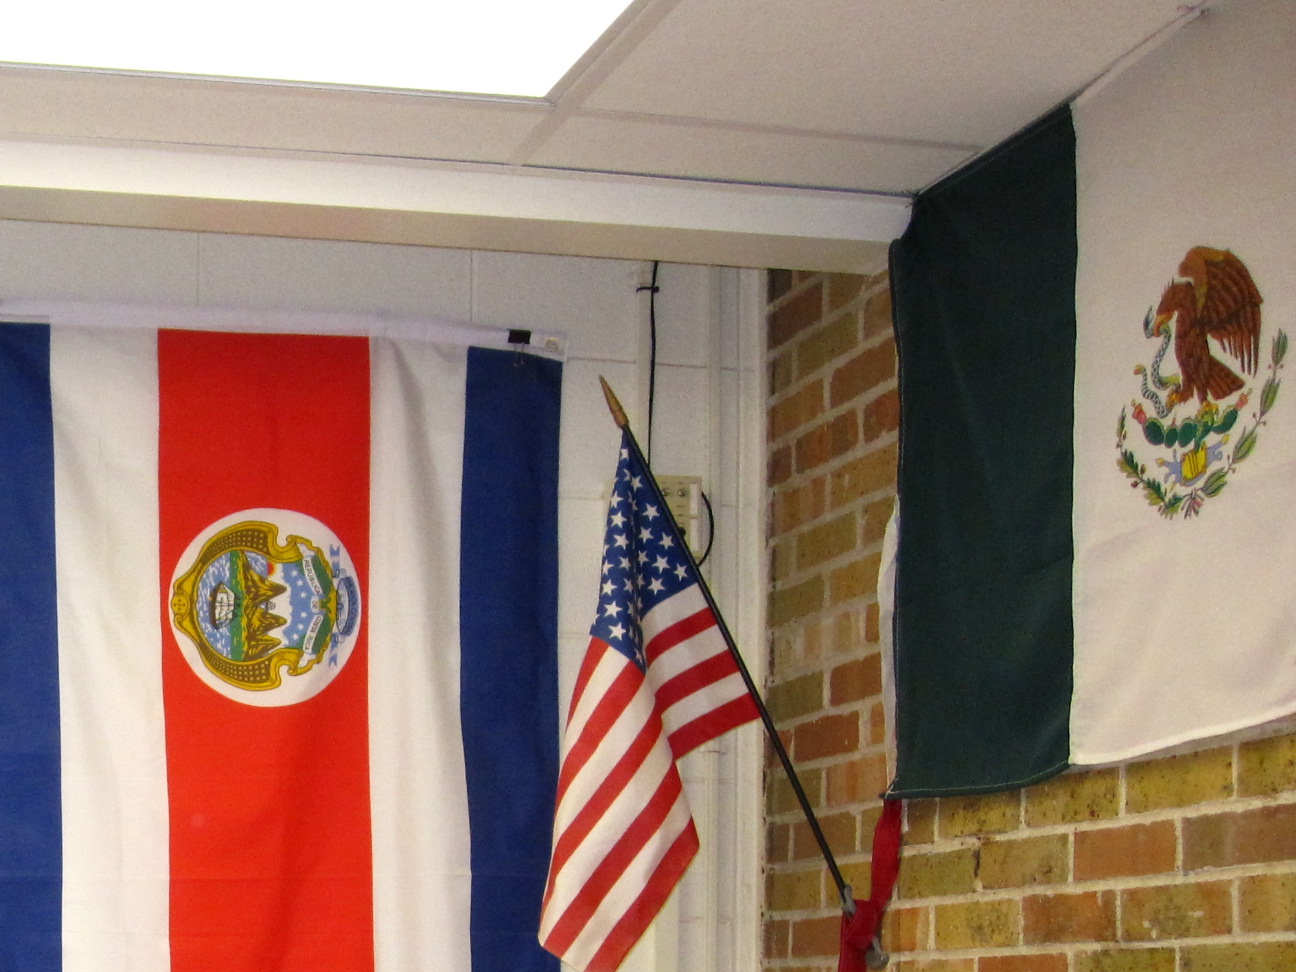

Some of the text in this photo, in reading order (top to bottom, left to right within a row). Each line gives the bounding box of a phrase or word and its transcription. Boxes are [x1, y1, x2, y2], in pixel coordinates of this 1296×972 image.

[312, 600, 318, 609] DE
[310, 616, 322, 633] COSTA
[304, 636, 314, 650] RICA
